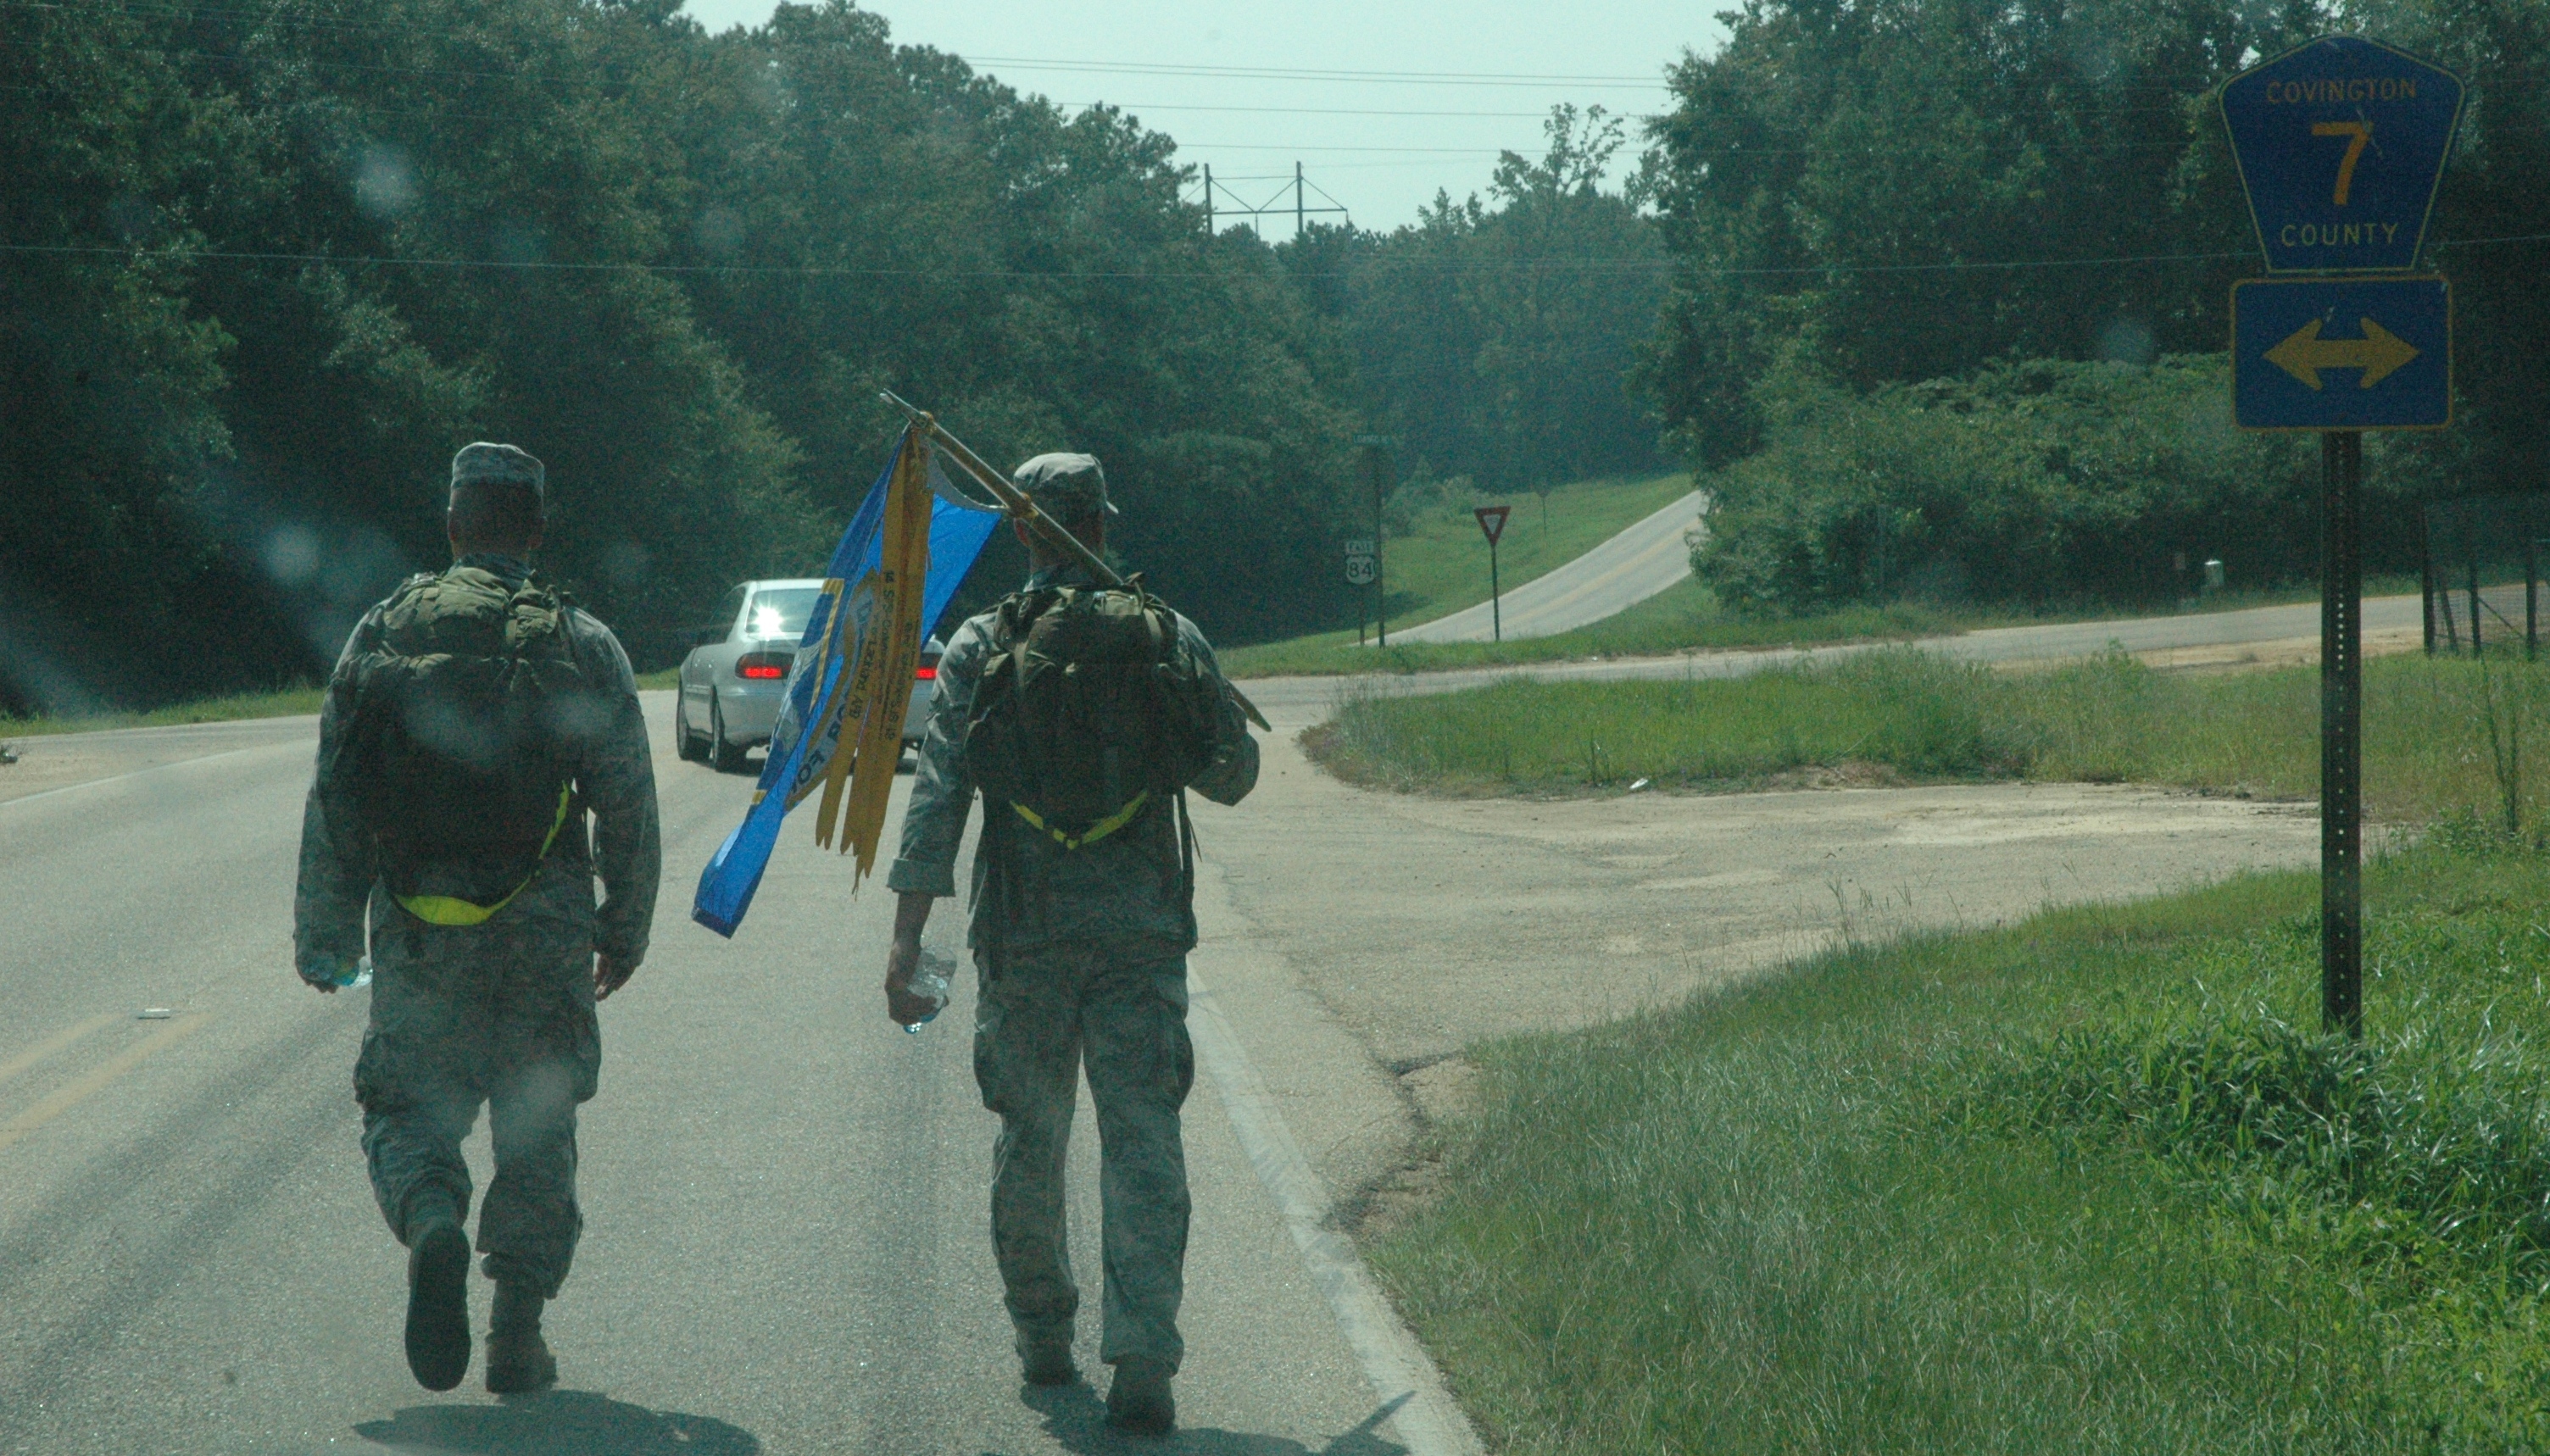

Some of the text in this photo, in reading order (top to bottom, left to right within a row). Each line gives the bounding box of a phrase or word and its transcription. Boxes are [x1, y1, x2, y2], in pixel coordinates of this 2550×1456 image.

[2267, 78, 2417, 103] COVINGTON
[2311, 121, 2373, 205] 7
[2280, 222, 2399, 247] COUNTY
[1349, 562, 1372, 577] 84
